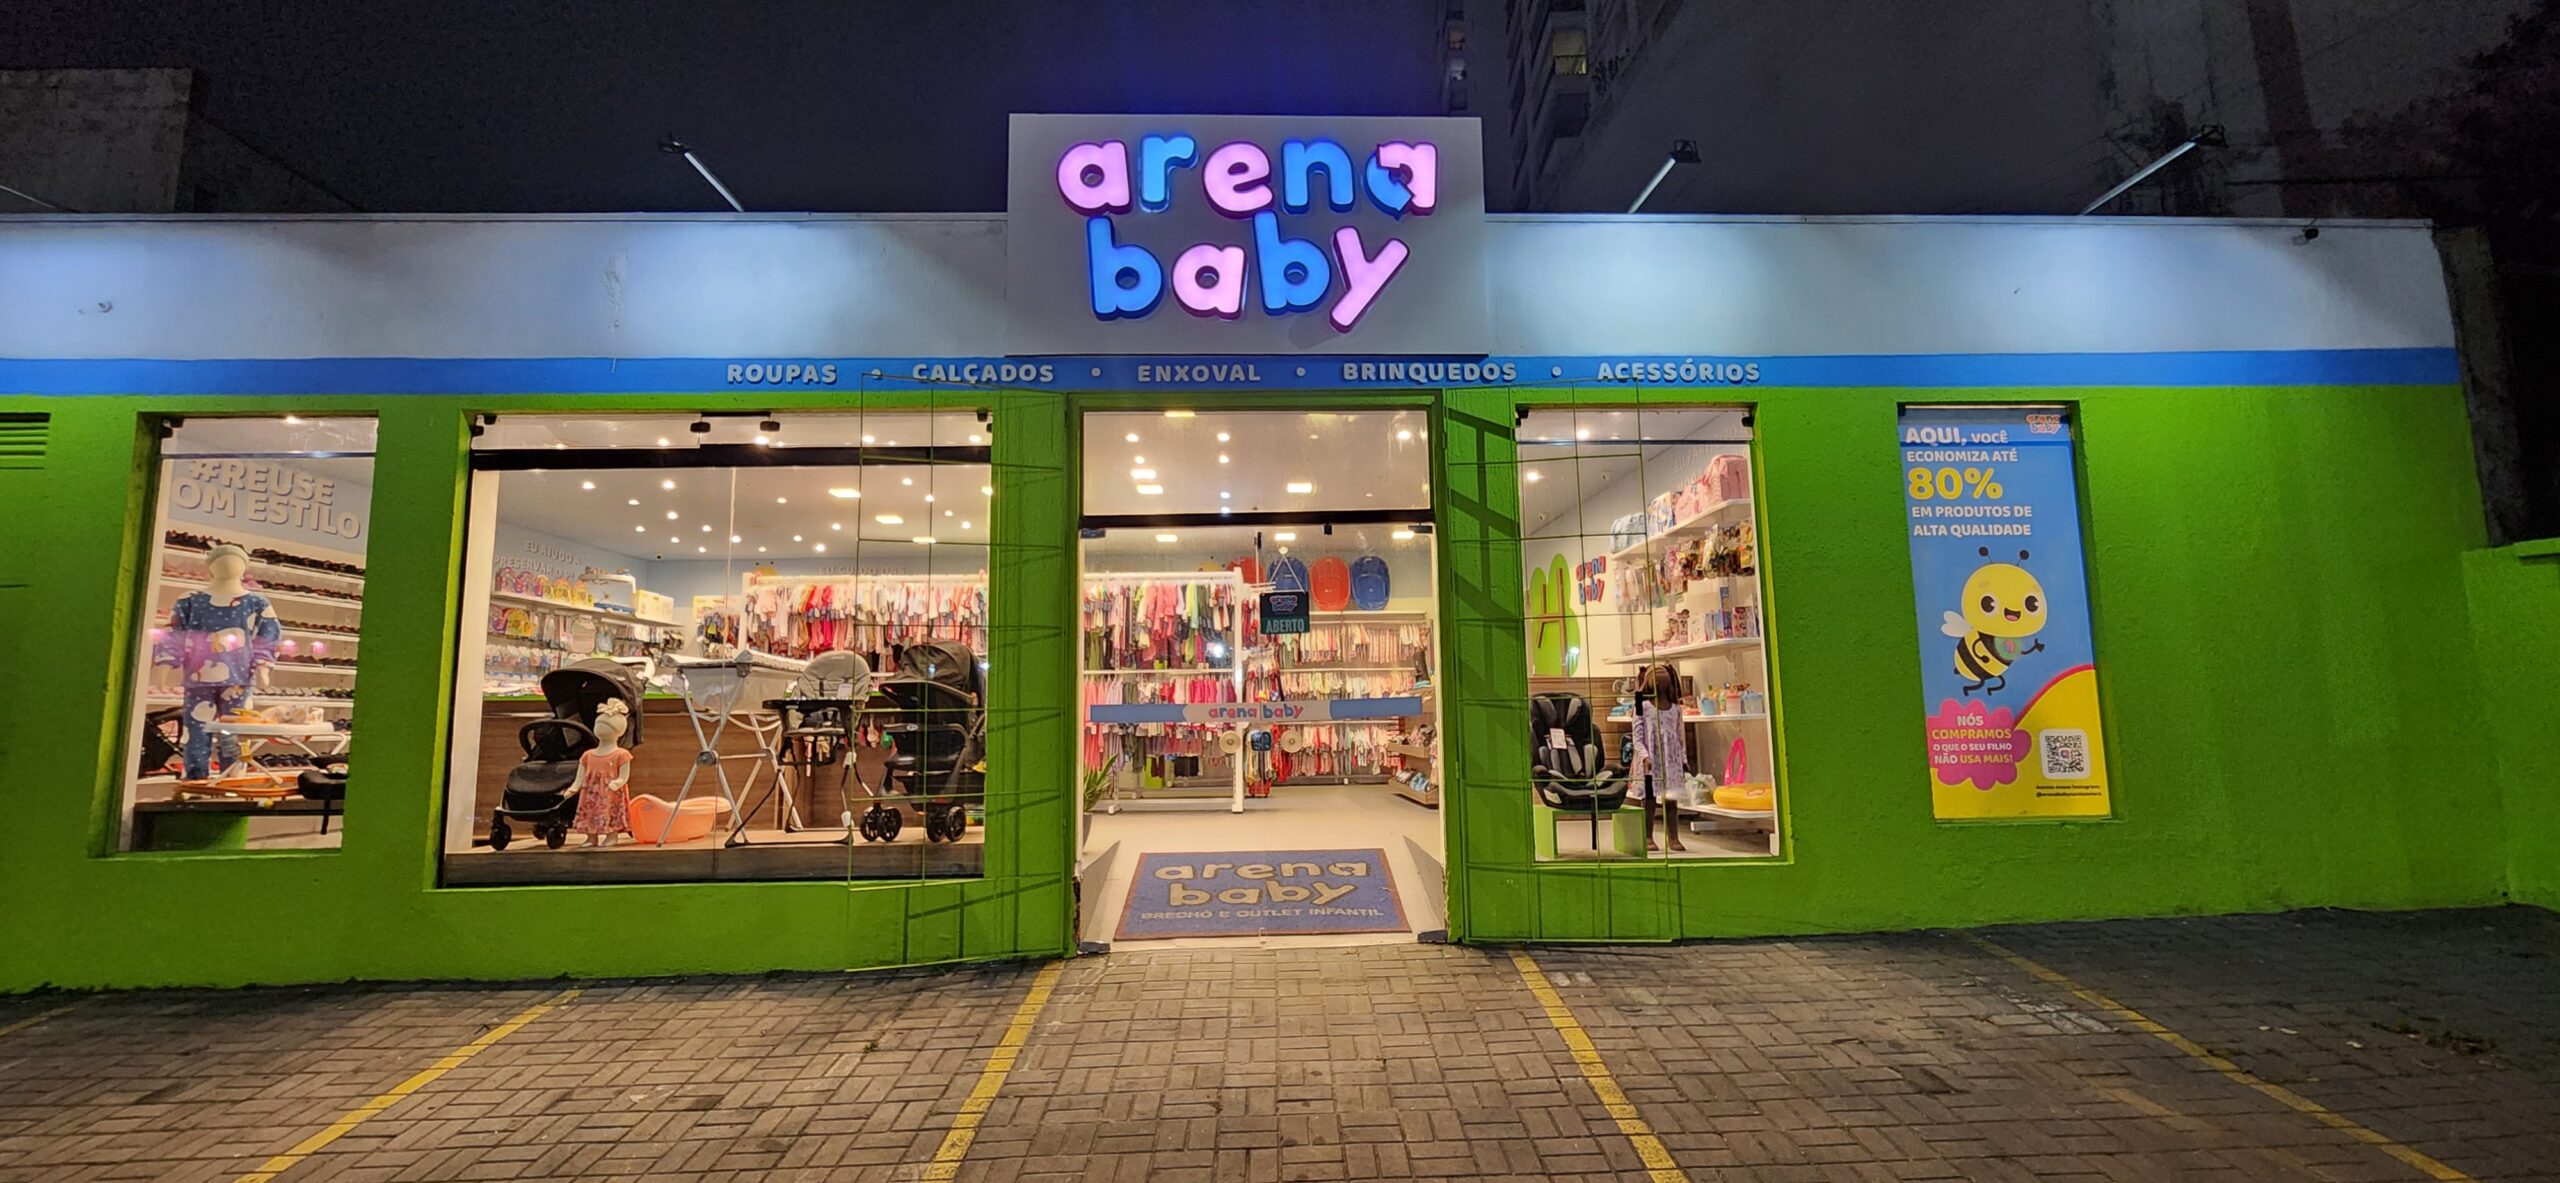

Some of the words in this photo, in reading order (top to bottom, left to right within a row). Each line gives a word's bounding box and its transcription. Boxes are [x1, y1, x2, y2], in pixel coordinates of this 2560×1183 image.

[1057, 135, 1438, 221] arena
[1087, 210, 1410, 334] baby
[727, 363, 838, 384] ROUPAS
[912, 363, 1054, 386] CALÇADOS
[1138, 364, 1262, 383] ENXOVAL
[1343, 362, 1518, 384] BRINQUEDOS
[1598, 358, 1761, 383] ACESSÓRIOS
[1905, 427, 1967, 447] AQUI,
[1907, 451, 1989, 462] ECONOMIZA
[1993, 448, 2018, 462] ATÉ
[190, 460, 335, 504] #REUSE
[1908, 467, 2003, 500] 80%
[249, 497, 361, 539] ESTILO
[1912, 506, 1932, 518] EM
[1936, 506, 2011, 517] PRODUTOS
[2014, 506, 2032, 517] DE
[1914, 525, 1948, 536] ALTA
[1951, 524, 2032, 538] QUALIDADE
[1578, 578, 1605, 605] baby
[1266, 618, 1304, 633] ABERTO
[1208, 705, 1257, 719] arena
[1262, 703, 1304, 720] baby
[1957, 712, 1984, 726] NÓS
[1932, 728, 2012, 740] COMPRAMOS
[1933, 743, 1940, 751] O
[1941, 743, 1960, 753] QUE
[1960, 743, 1968, 751] O
[1969, 743, 1986, 751] SEU
[1987, 742, 2012, 751] FILHO
[1934, 752, 1958, 764] NÃO
[1960, 754, 1981, 764] USA
[1154, 860, 1371, 880] arena
[1167, 879, 1358, 907] baby
[1219, 911, 1231, 919] E
[1237, 908, 1301, 918] OUTLET
[1309, 907, 1384, 917] INFANTIL
